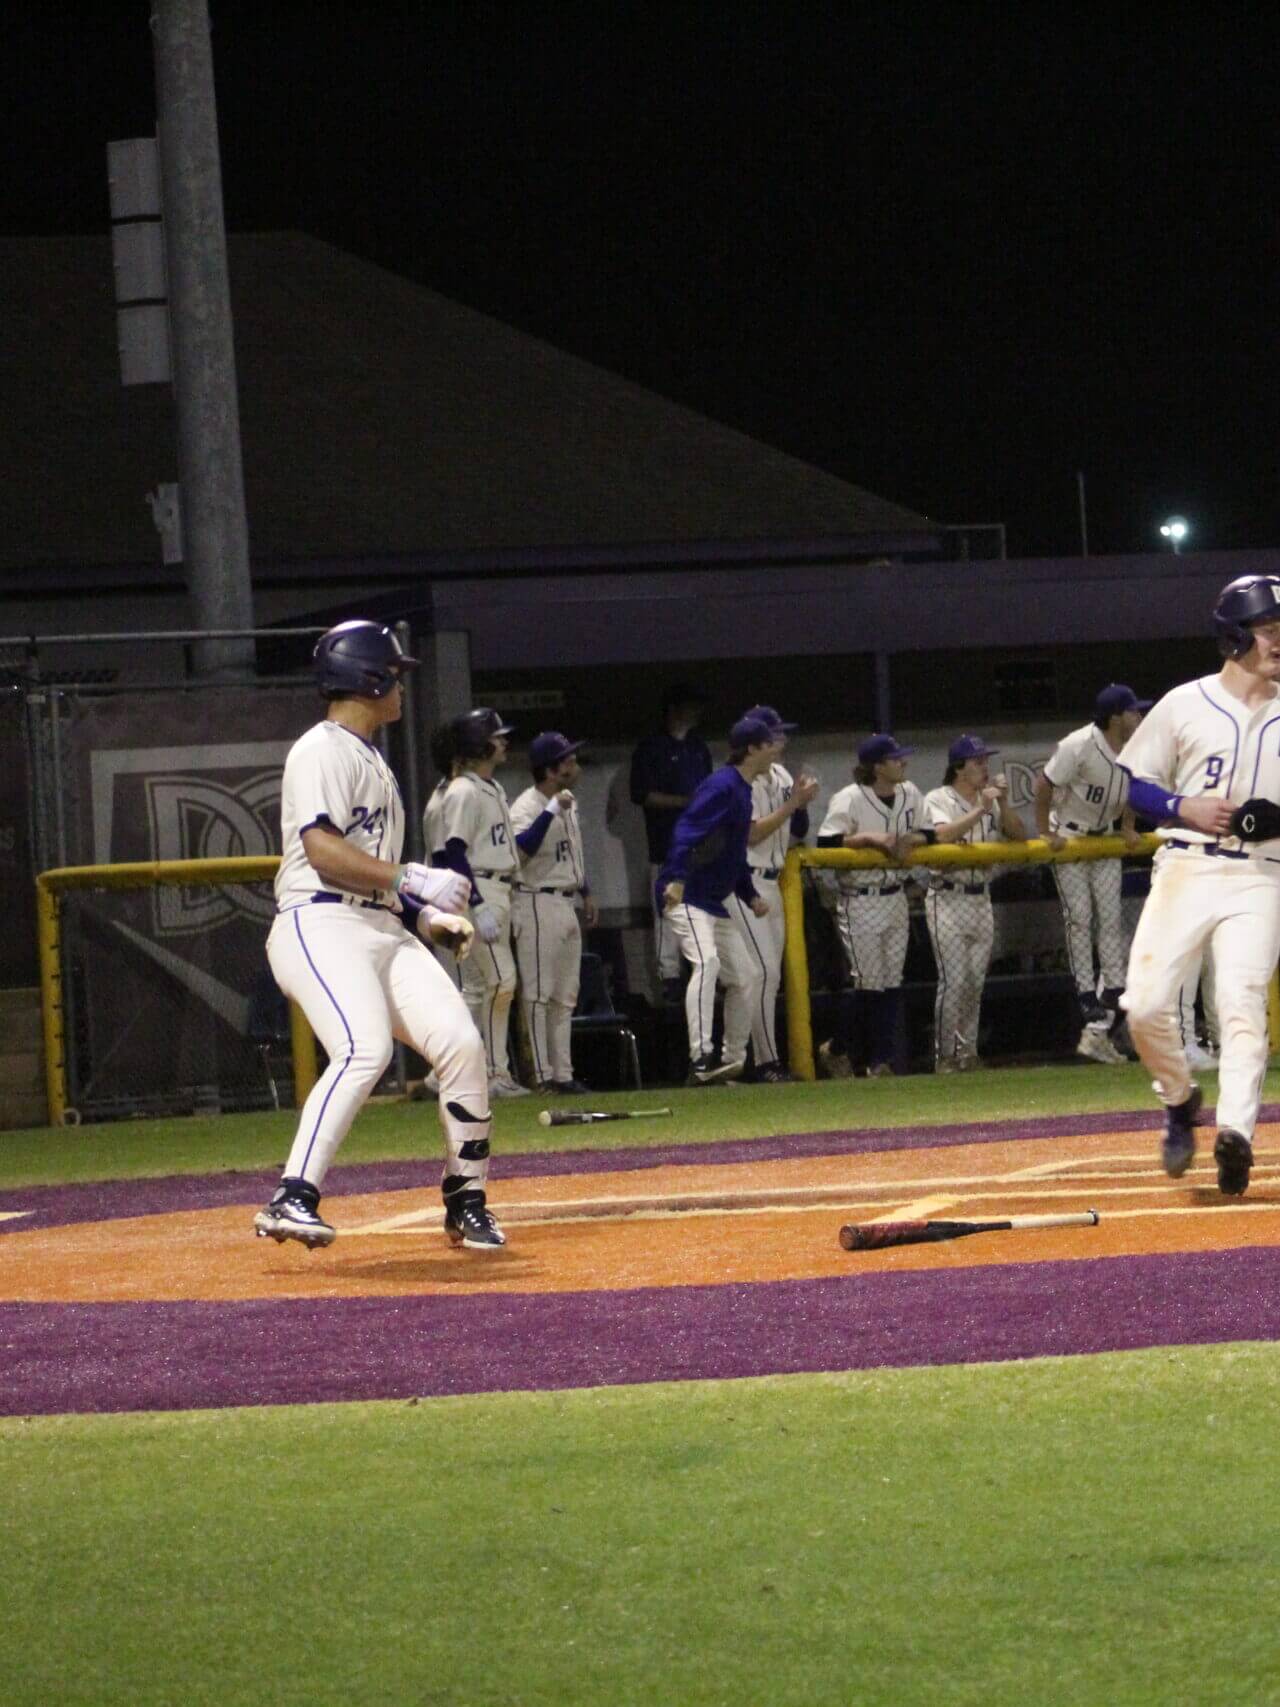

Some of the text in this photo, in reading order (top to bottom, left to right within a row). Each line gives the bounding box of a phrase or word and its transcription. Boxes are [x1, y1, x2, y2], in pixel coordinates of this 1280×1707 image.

[1203, 756, 1223, 789] 9
[1086, 784, 1104, 804] 18
[345, 806, 381, 835] 24
[490, 823, 505, 846] 12
